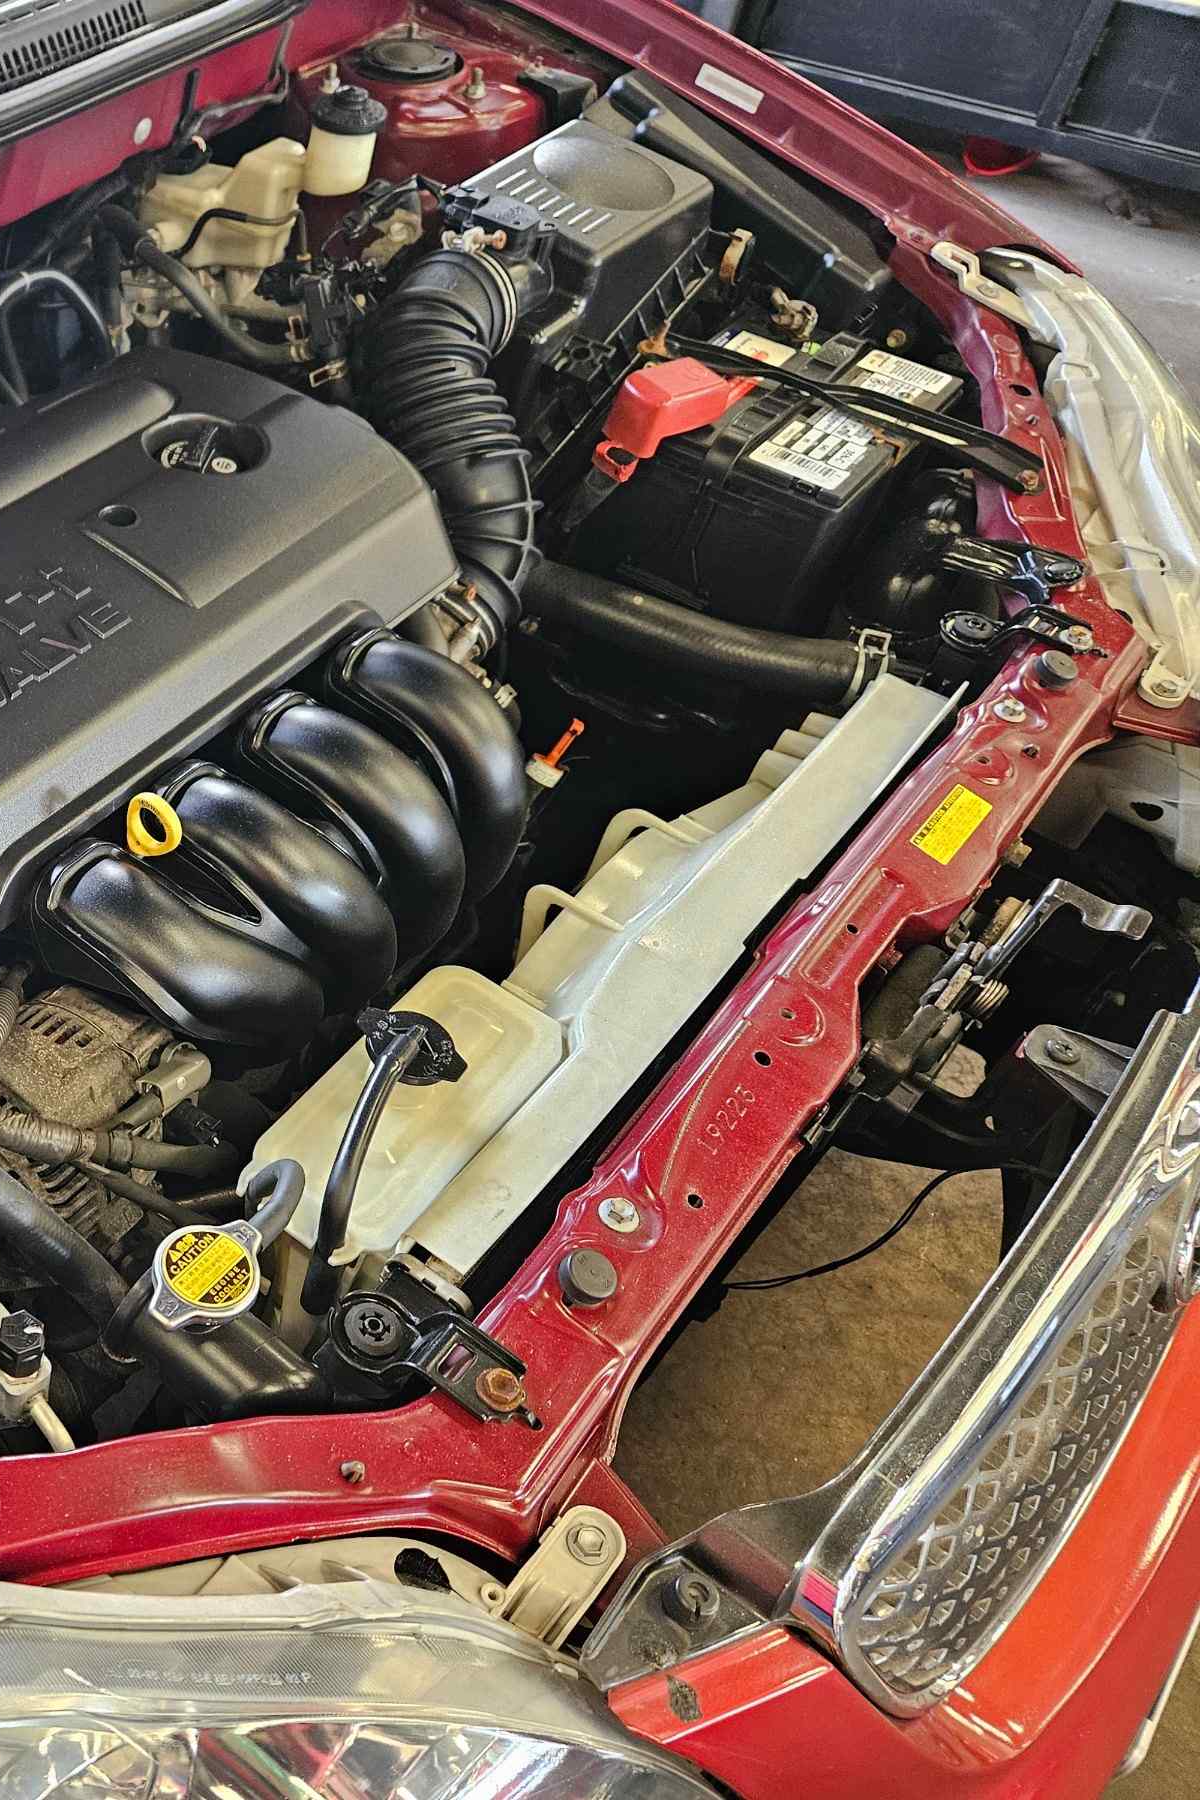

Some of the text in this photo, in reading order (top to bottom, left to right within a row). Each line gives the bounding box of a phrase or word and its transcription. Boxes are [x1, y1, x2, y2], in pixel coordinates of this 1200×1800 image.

[169, 1233, 215, 1275] CAUTION
[209, 1267, 241, 1296] ENGINE
[213, 1268, 249, 1303] COOLANT
